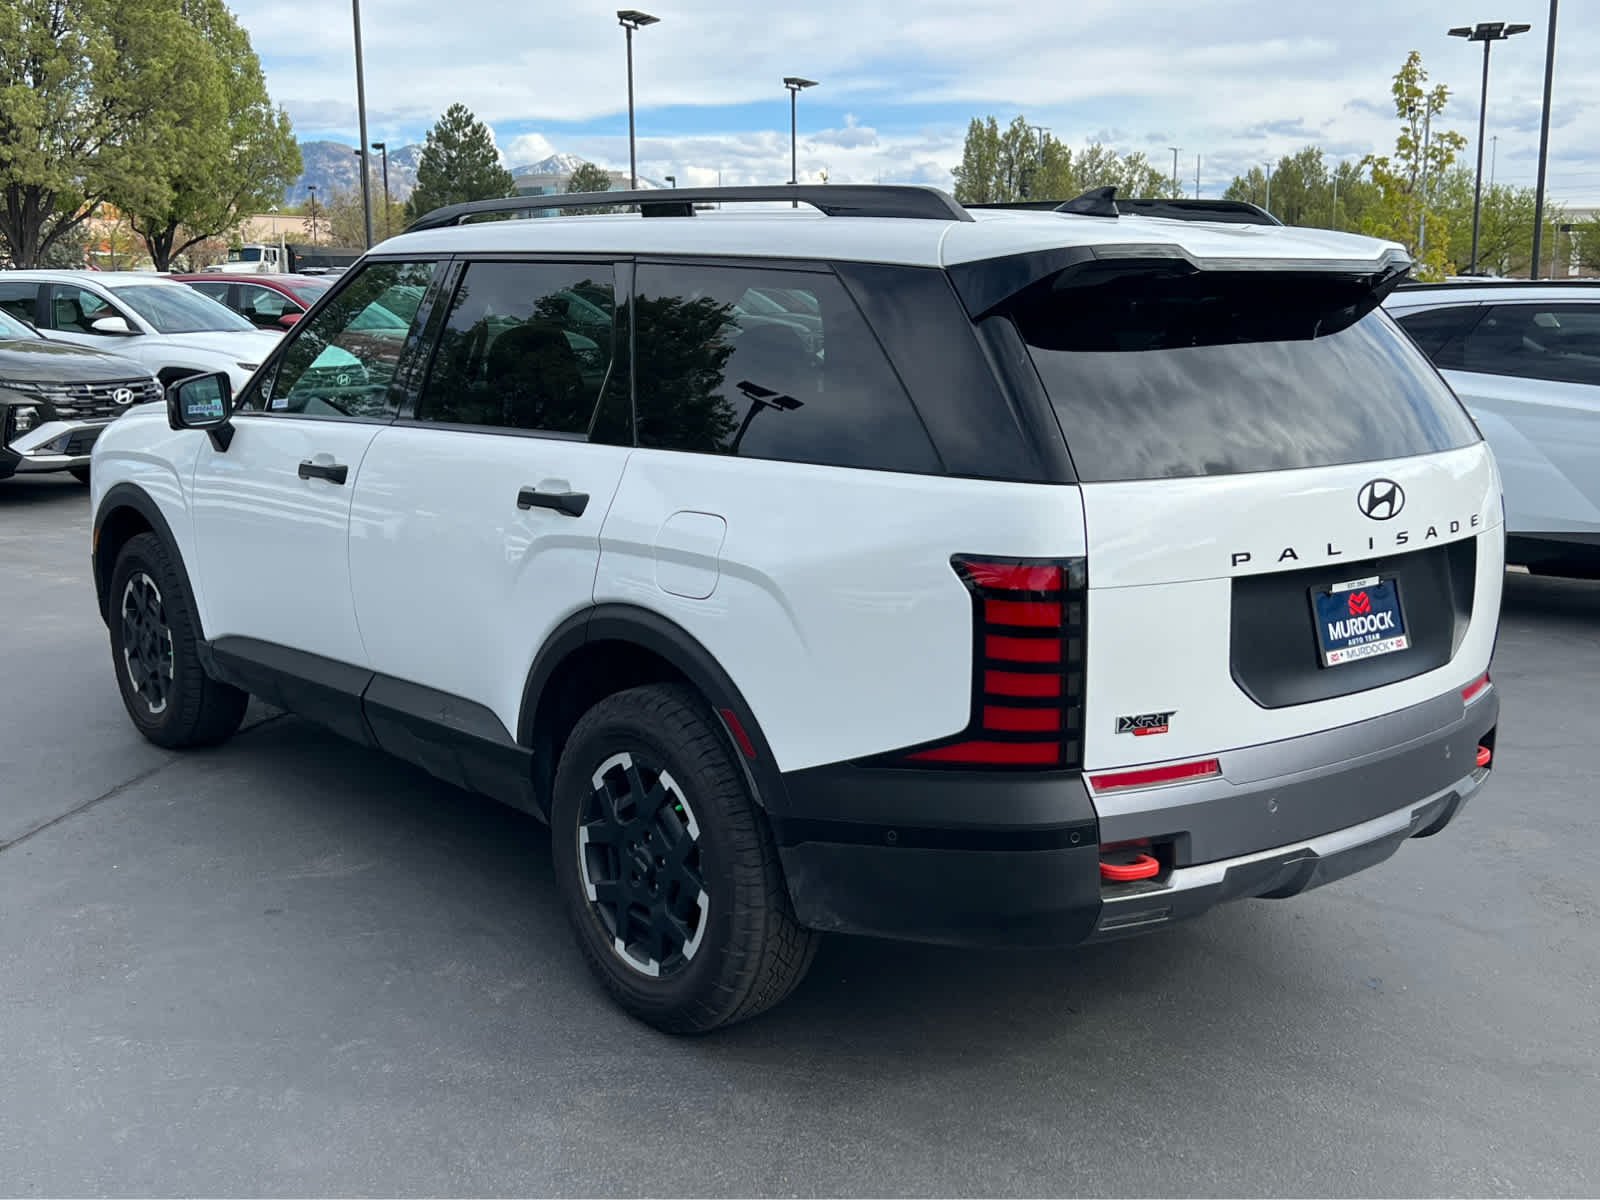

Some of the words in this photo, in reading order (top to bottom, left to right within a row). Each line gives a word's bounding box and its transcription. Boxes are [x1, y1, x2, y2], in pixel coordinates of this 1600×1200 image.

[1231, 514, 1479, 567] PALISADE
[1328, 610, 1395, 641] MURDOCK
[1348, 637, 1363, 646] AUTO
[1365, 633, 1380, 642] TEAM
[1346, 641, 1391, 659] MURDOCK
[1117, 710, 1177, 732] XRT
[1146, 725, 1168, 735] PRO
